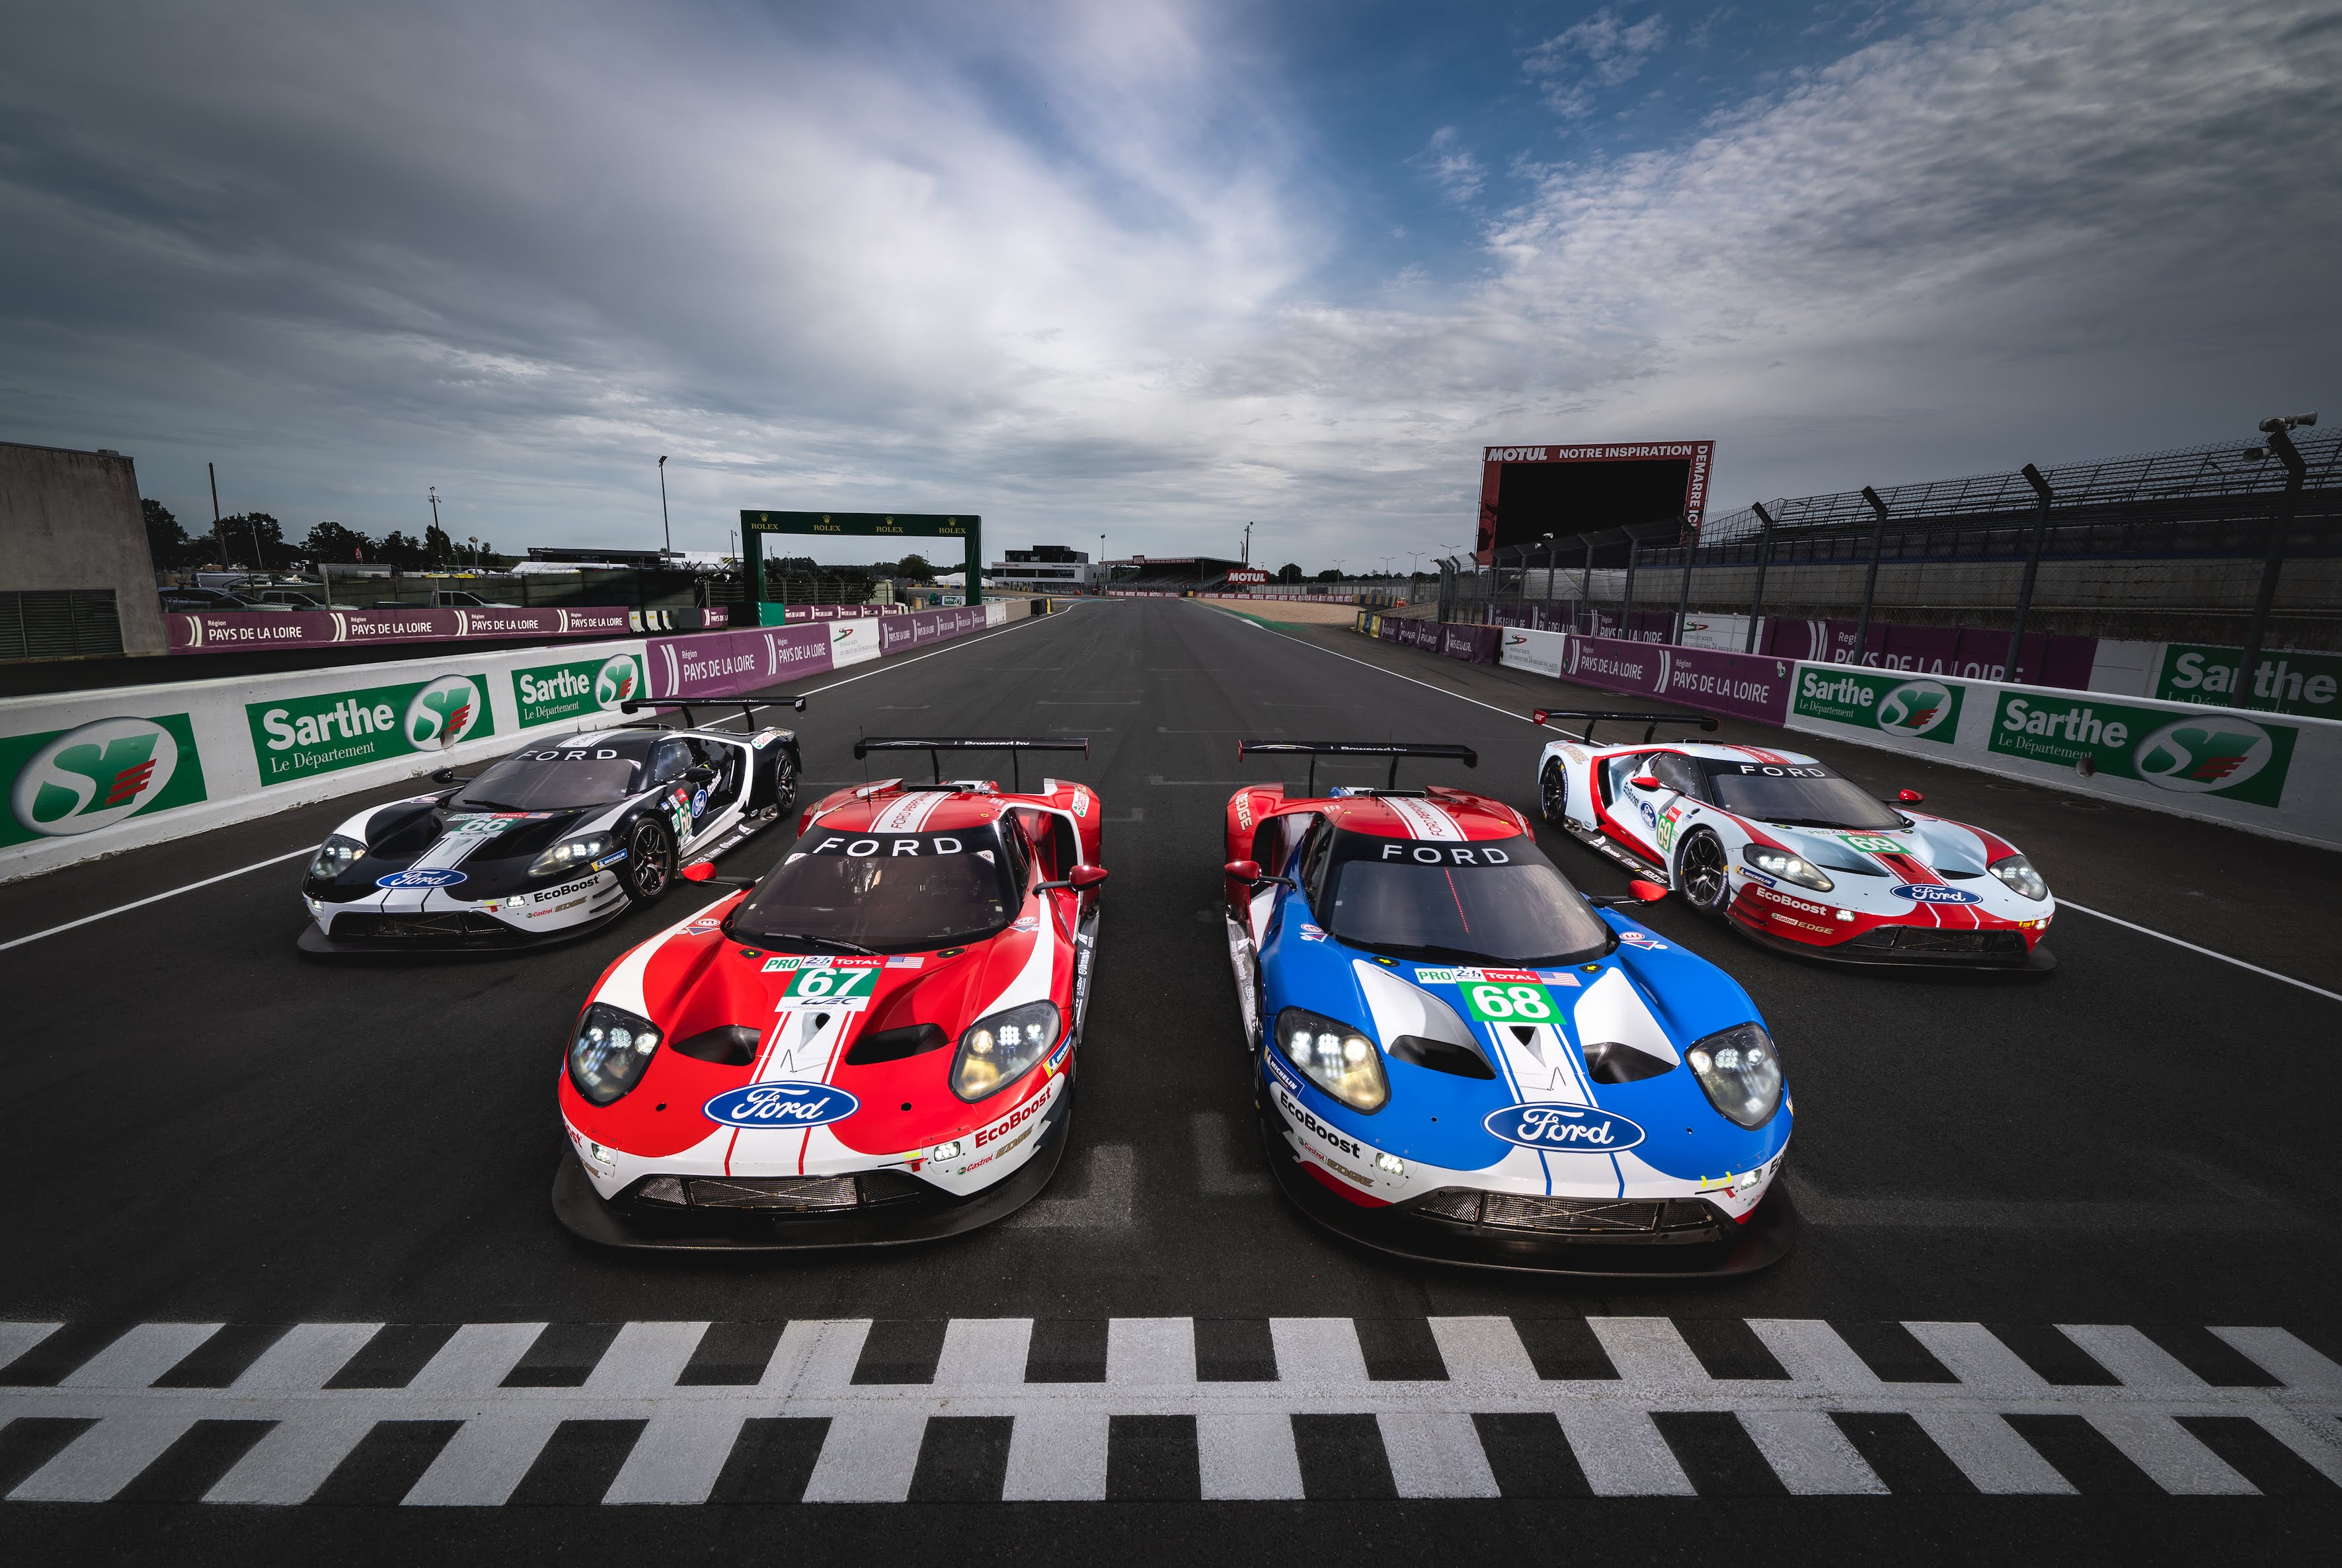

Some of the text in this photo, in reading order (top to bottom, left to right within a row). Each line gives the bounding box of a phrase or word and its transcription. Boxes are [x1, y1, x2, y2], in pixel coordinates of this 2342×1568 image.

[1487, 445, 1692, 461] MOTUL NOTRE INSPIRATION
[1689, 445, 1708, 508] DEMARRE
[1228, 572, 1265, 582] MOTUL
[352, 622, 432, 635] PAYS DE LA LOIRE
[472, 619, 538, 630] PAYS DE LA LOIRE
[571, 618, 587, 627] PAYS
[588, 618, 596, 627] DE
[607, 617, 623, 626] LOIRE
[209, 627, 302, 641] PAYS DE LA LOIRE
[682, 650, 697, 659] Région
[779, 647, 794, 664] PAYS
[795, 646, 802, 660] DE
[803, 645, 810, 659] LA
[811, 643, 826, 658] LOIRE
[1676, 659, 1692, 668] Région
[683, 654, 755, 682] PAYS DE LA LOIRE
[1581, 655, 1643, 680] PAYS DE LA LOIRE
[520, 669, 590, 704] Sarthe
[1672, 670, 1770, 704] PAYS DE LA LOIRE
[1802, 673, 1874, 707] Sarthe
[524, 701, 579, 721] Le Département
[795, 699, 804, 707] GT
[1799, 699, 1854, 718] Le Département
[263, 698, 395, 750] Sarthe
[2002, 699, 2128, 748] Sarthe
[514, 749, 617, 761] FORD
[1561, 745, 1590, 765] EDGE
[1998, 732, 2093, 760] Le Département
[270, 741, 375, 773] Le Département
[1740, 765, 1825, 778] FORD
[695, 793, 705, 816] Ford
[1235, 797, 1253, 831] EDGE
[1668, 809, 1678, 820] TOTAL
[461, 818, 513, 832] 66
[680, 803, 691, 836] 66
[891, 812, 911, 829] FORD
[1642, 804, 1655, 828] Ford
[1424, 818, 1445, 837] FORD
[1657, 818, 1672, 850] 69
[812, 837, 962, 857] FORD
[1382, 844, 1509, 865] FORD
[1848, 836, 1900, 852] 69
[604, 851, 626, 865] MICHELIN
[390, 869, 452, 887] Ford
[534, 875, 599, 902] EcoBoost
[1744, 872, 1772, 885] MICHELIN
[1713, 877, 1727, 906] MICHELIN
[1756, 886, 1827, 916] EcoBoost
[1911, 884, 1966, 903] Ford
[533, 896, 588, 918] Castrol EDGE
[1777, 915, 1834, 935] Castrol EDGE
[765, 959, 800, 969] PRO
[797, 968, 873, 997] 67
[1419, 971, 1452, 980] PRO
[1485, 972, 1537, 981] TOTAL
[1472, 985, 1551, 1019] 68
[1270, 1060, 1297, 1090] MICHELIN
[731, 1087, 830, 1119] Ford
[975, 1085, 1052, 1148] EcoBoost
[1280, 1090, 1360, 1159] EcoBoost
[1517, 1108, 1615, 1144] Ford
[966, 1123, 1034, 1173] Castrol EDGE
[1304, 1142, 1374, 1187] Castrol EDGE
